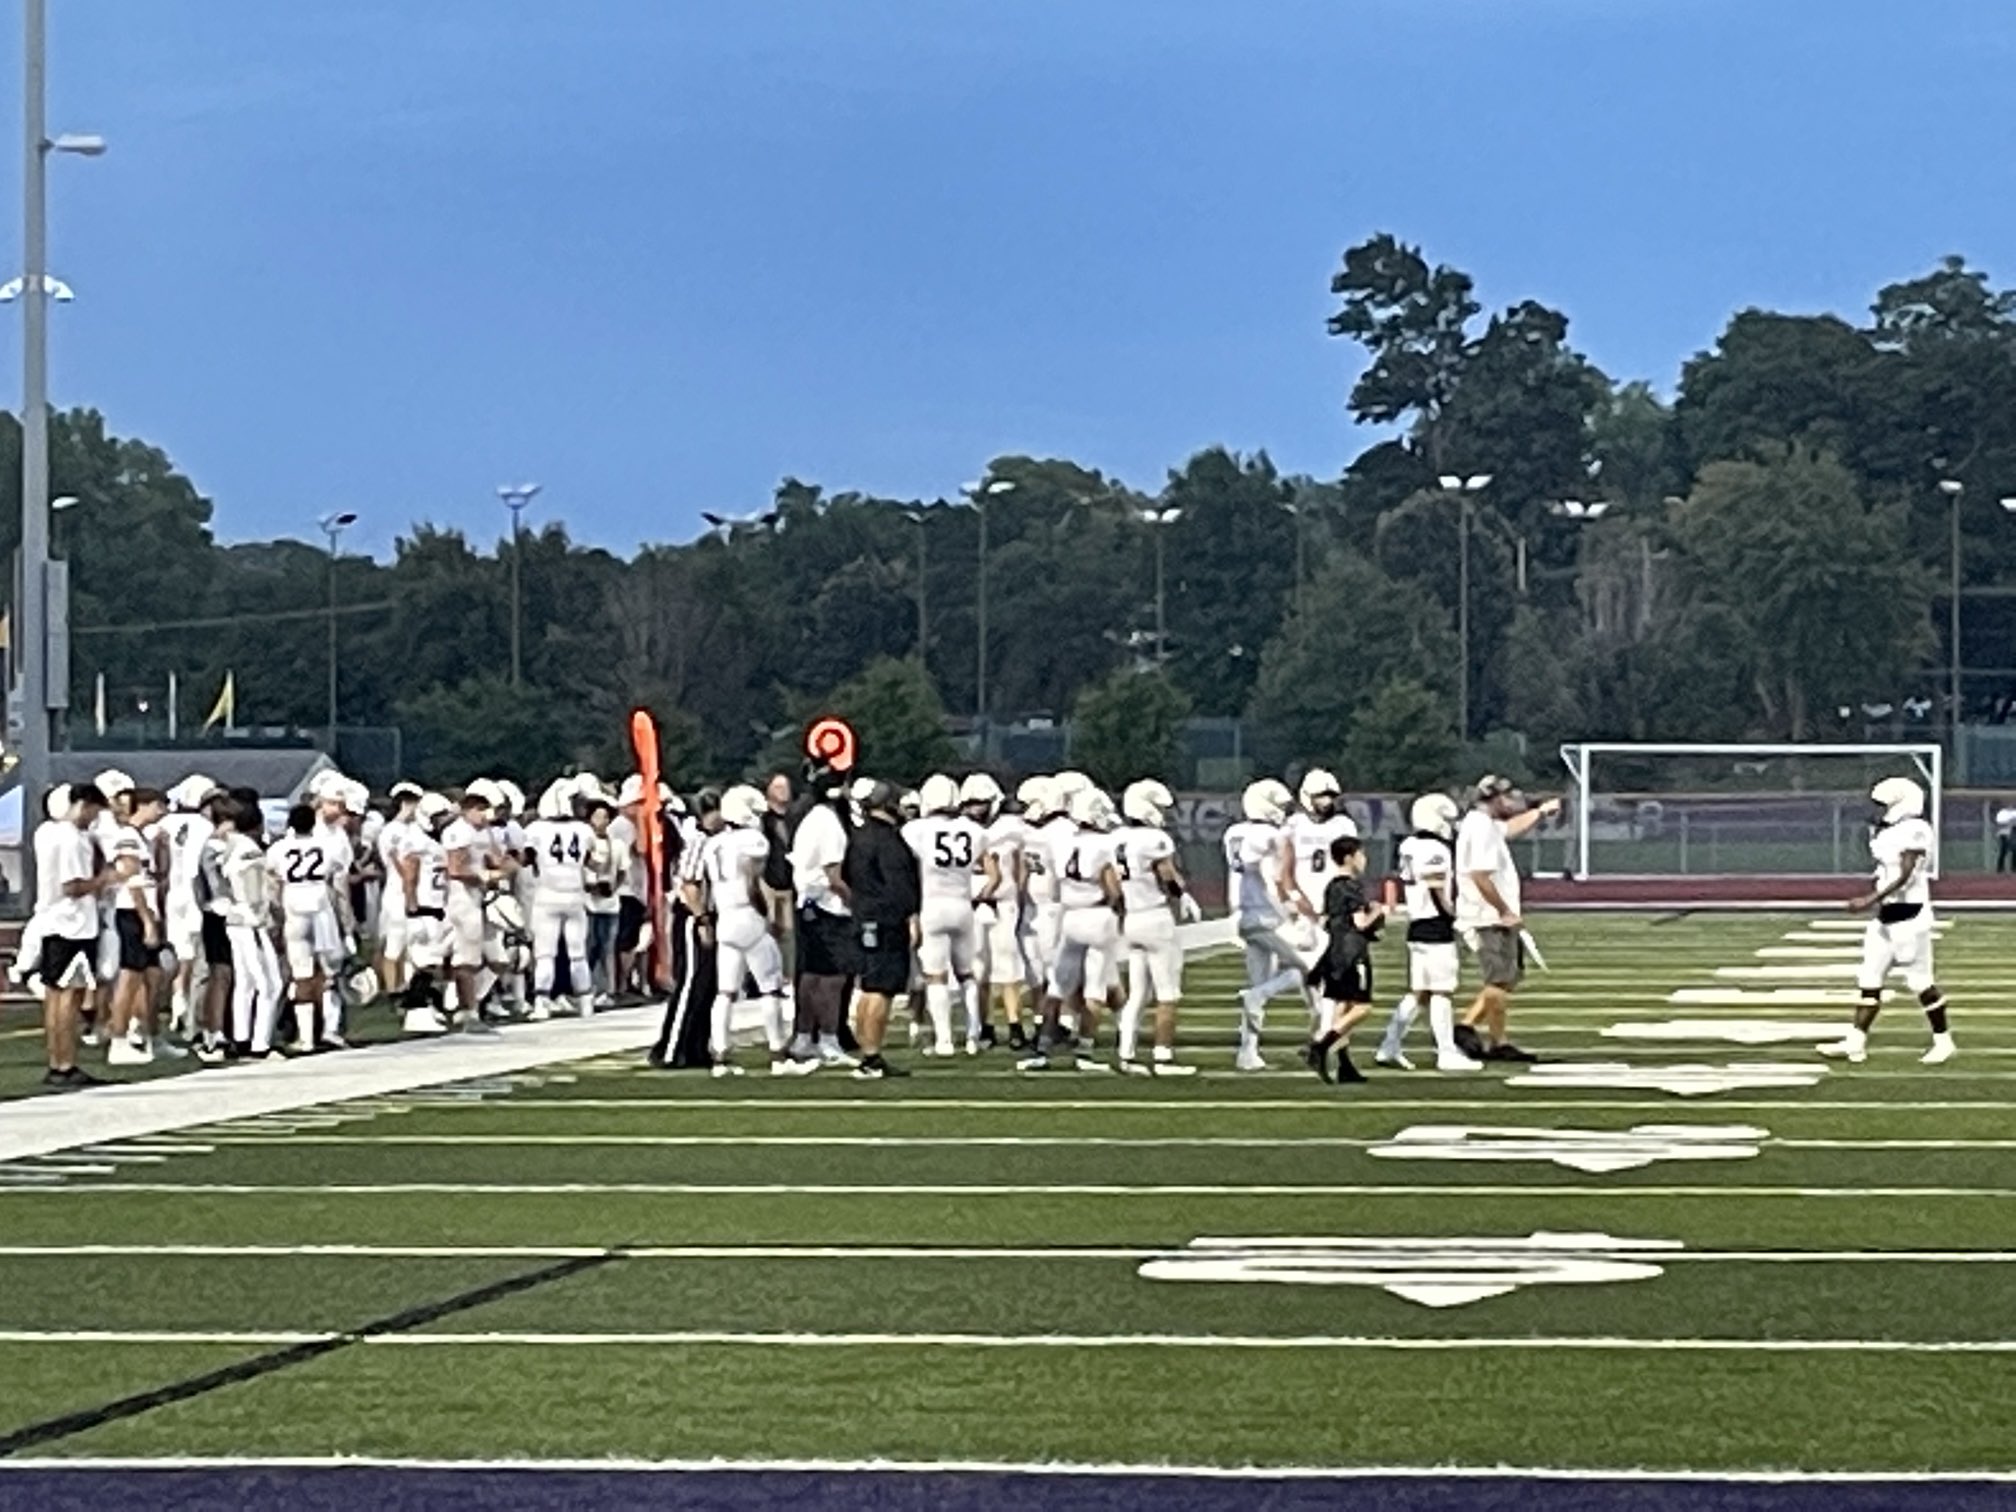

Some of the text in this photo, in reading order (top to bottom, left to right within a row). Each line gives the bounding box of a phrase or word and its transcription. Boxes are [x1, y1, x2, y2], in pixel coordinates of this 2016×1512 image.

[550, 832, 581, 863] 44
[935, 832, 972, 867] 53
[285, 848, 326, 883] 22
